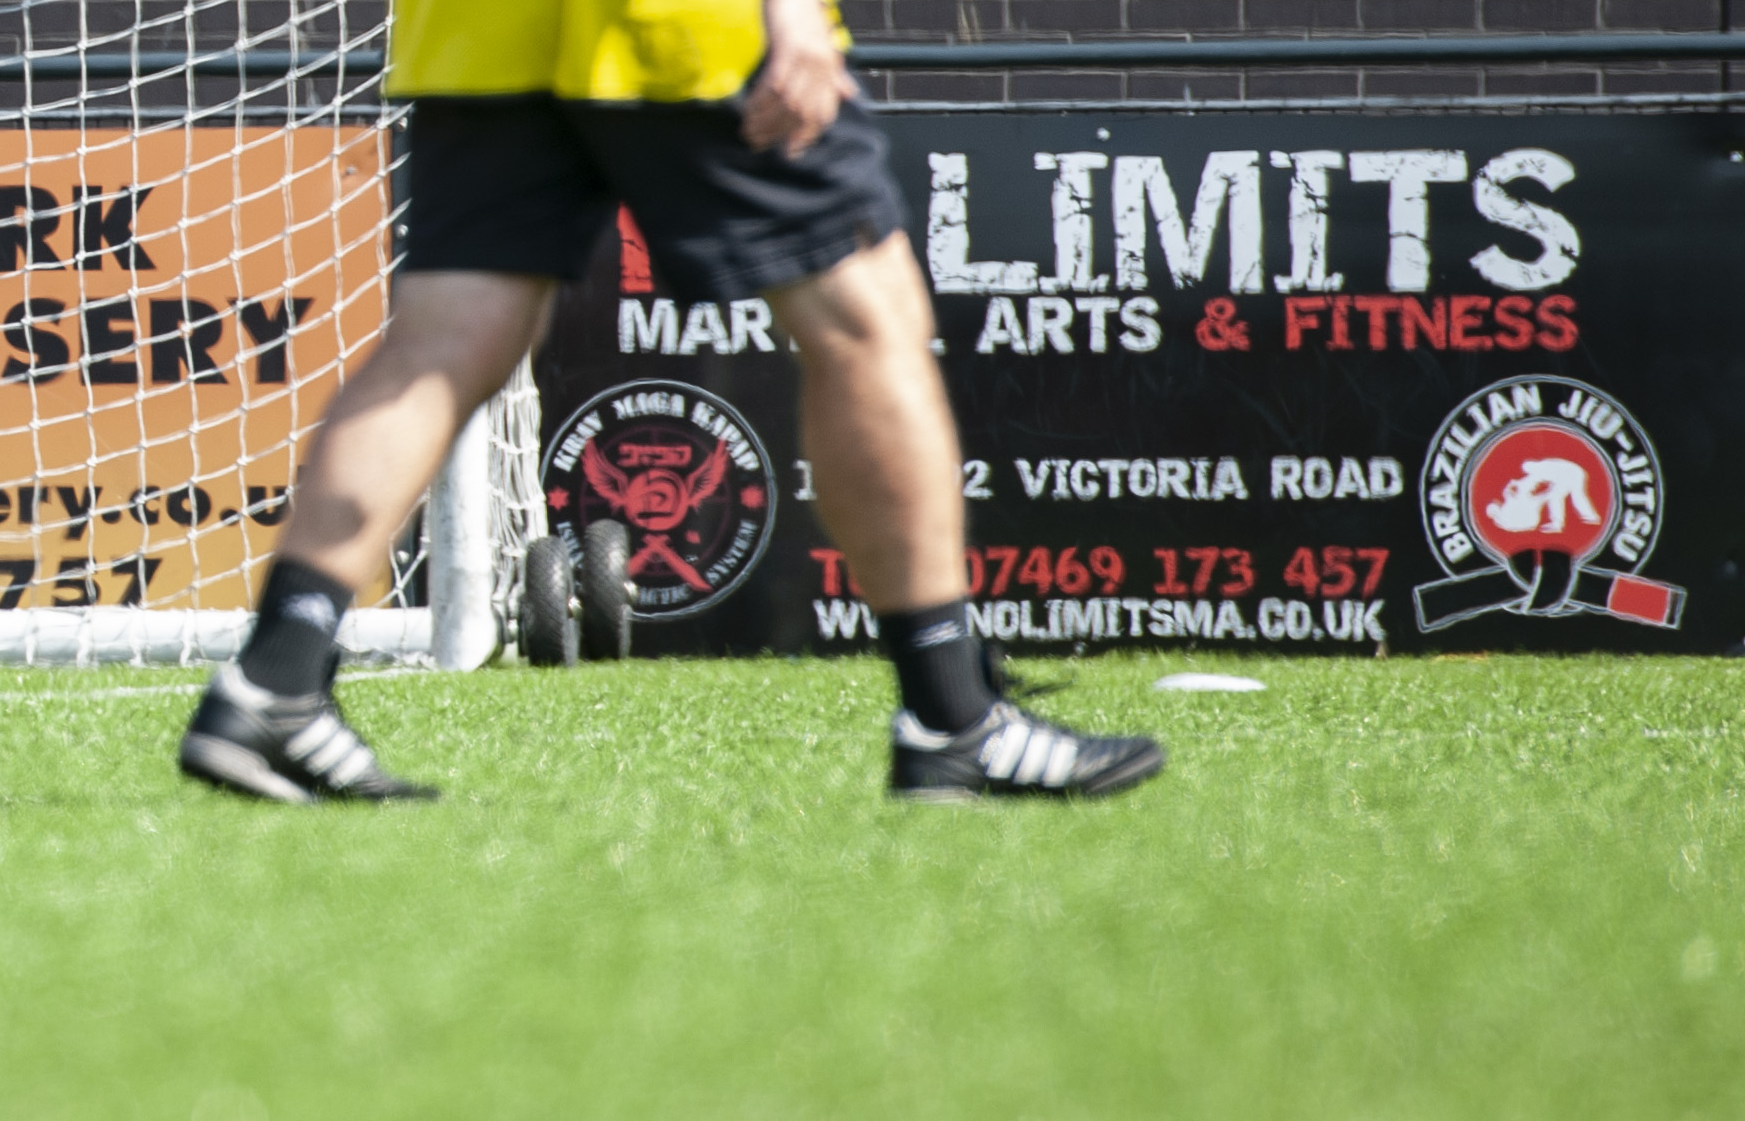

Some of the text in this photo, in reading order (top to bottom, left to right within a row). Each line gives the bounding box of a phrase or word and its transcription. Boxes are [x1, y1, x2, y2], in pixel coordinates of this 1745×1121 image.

[926, 149, 1581, 294] LIMITS
[975, 294, 1580, 356] ARTS & FITNESS
[1013, 456, 1249, 501] VICTORIA
[1270, 456, 1404, 500] ROAD
[1429, 383, 1656, 565] BRAZILIAN JIU-JITSU
[1152, 546, 1255, 595] 173
[1284, 547, 1390, 597] 457
[812, 596, 1387, 643] WNOLIMITSMA.CO.UK
